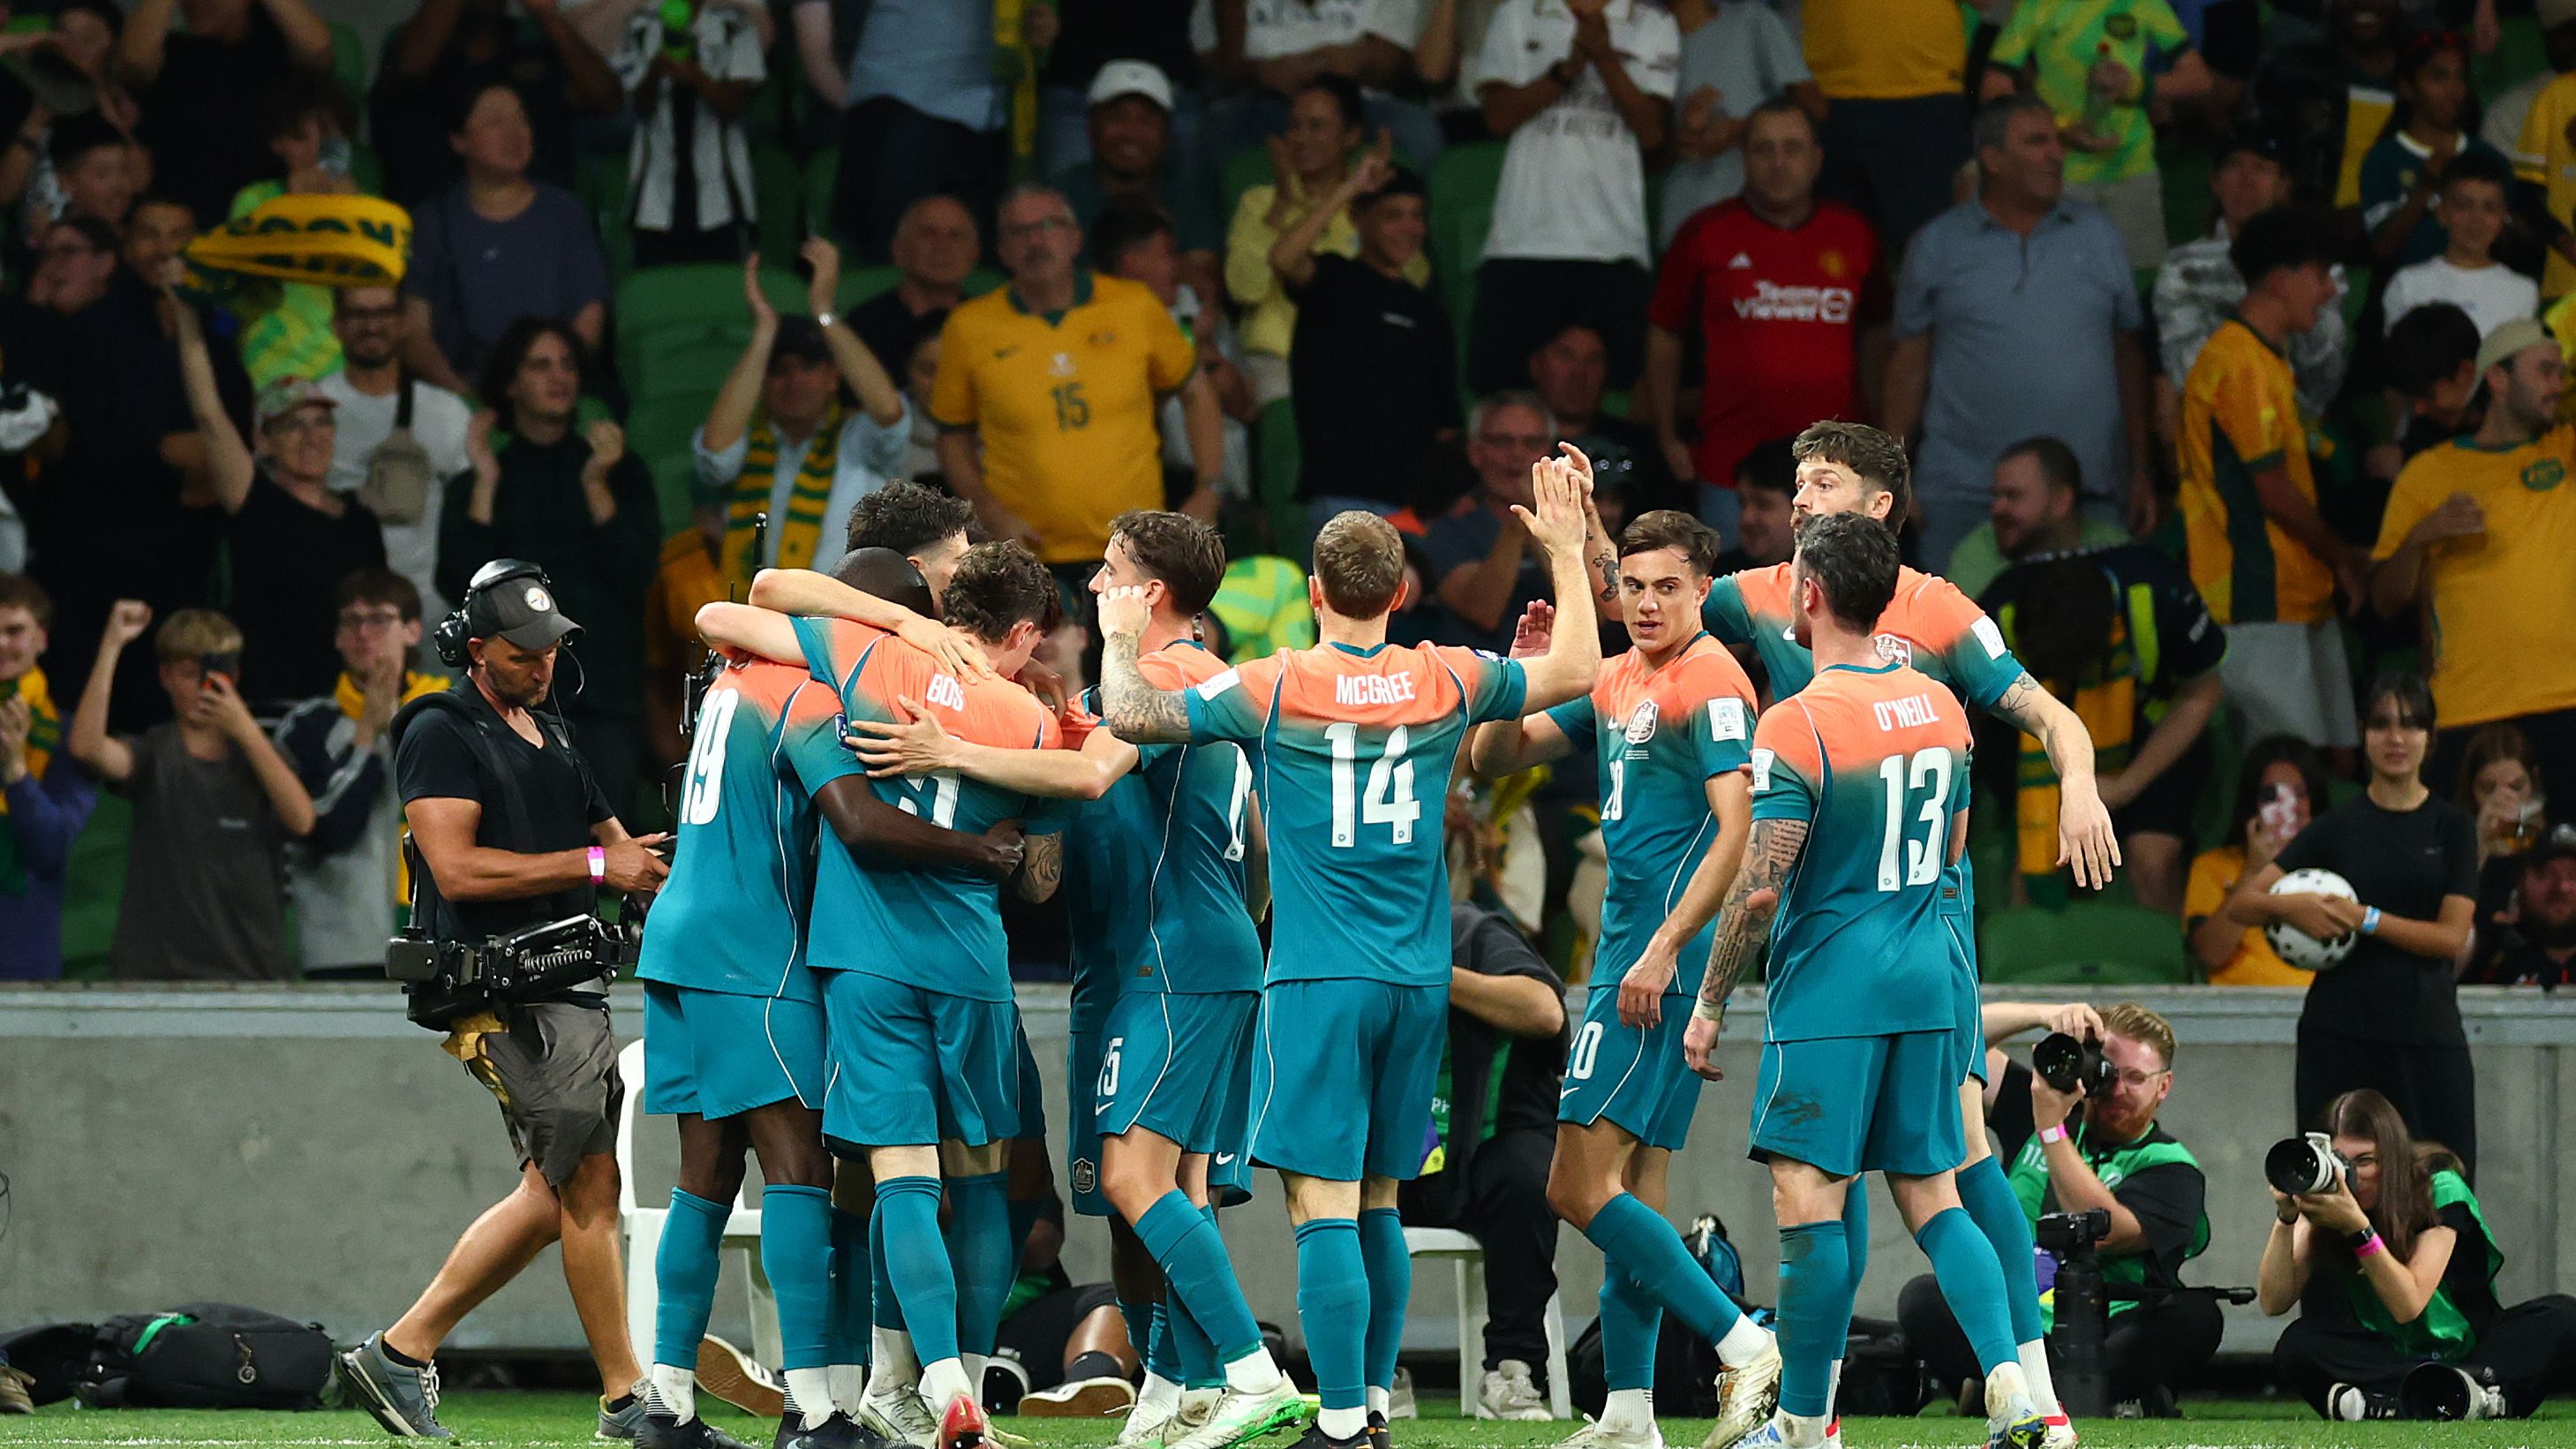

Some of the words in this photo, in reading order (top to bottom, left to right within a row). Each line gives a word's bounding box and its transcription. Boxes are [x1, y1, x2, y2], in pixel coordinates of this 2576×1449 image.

[1051, 381, 1091, 432] 15
[926, 673, 965, 713] BOS
[1335, 671, 1415, 706] MCGREE
[1872, 693, 1940, 731] O'NEILL
[681, 688, 739, 825] 19
[1324, 722, 1420, 848] 14
[1878, 746, 1953, 892] 13
[1564, 1021, 1603, 1080] 0
